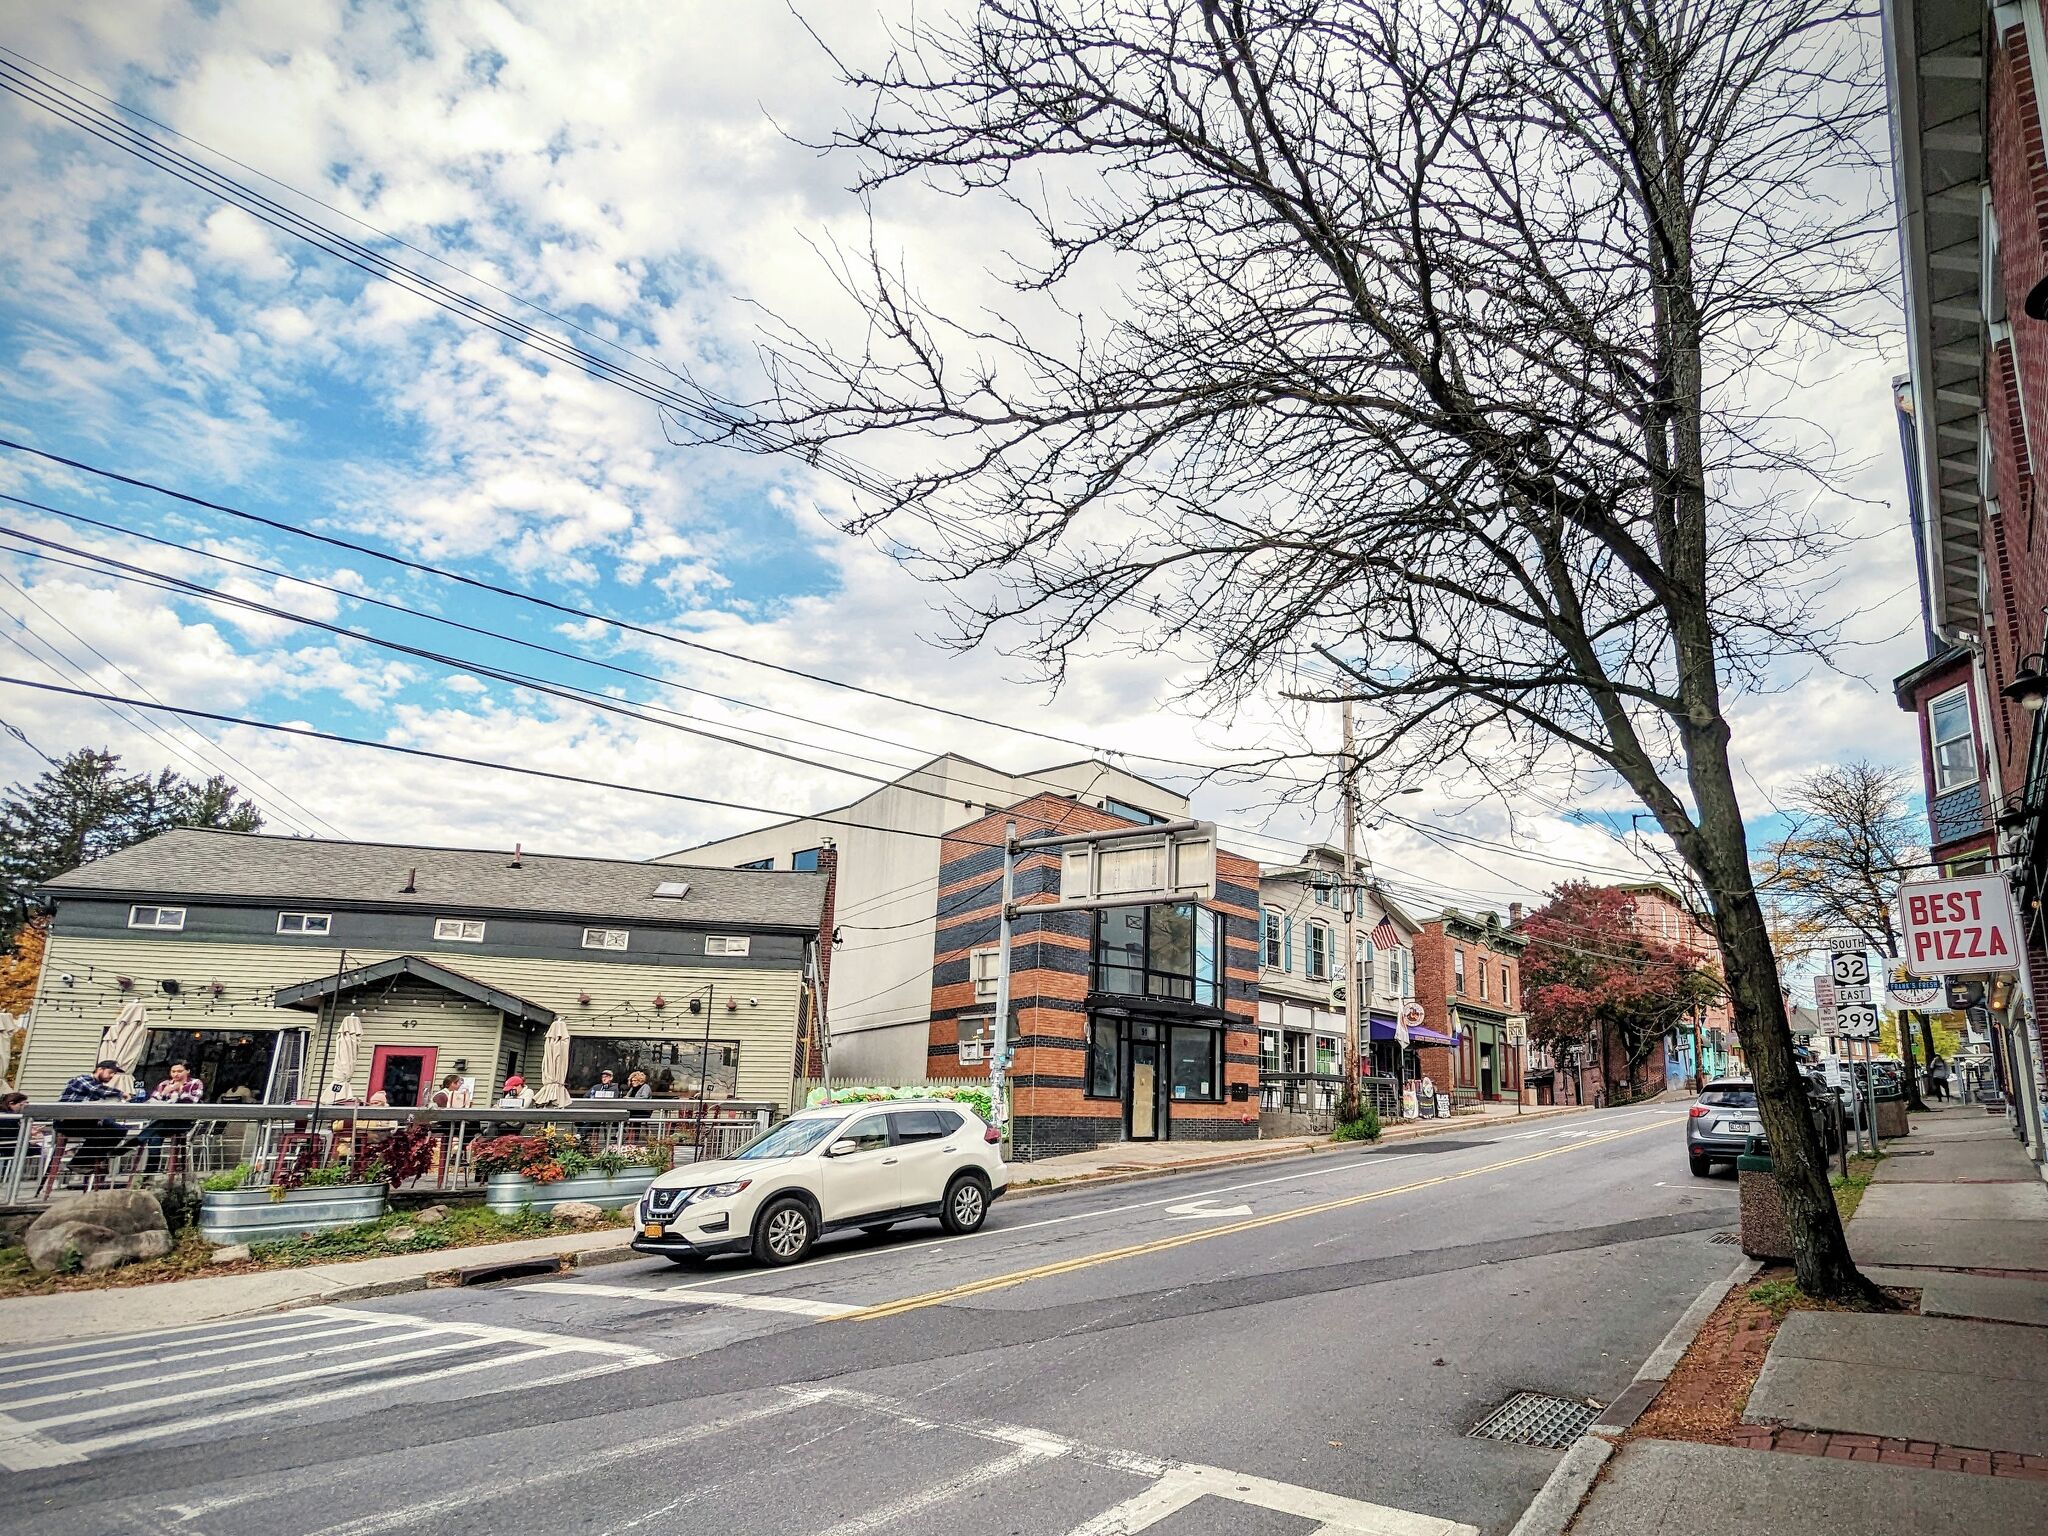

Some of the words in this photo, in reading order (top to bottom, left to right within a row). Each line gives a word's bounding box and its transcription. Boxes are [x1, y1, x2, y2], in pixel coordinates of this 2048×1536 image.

[1909, 891, 1982, 926] BEST
[1832, 938, 1864, 950] SOUTH
[1915, 926, 2008, 962] PIZZA
[1836, 960, 1865, 978] 32
[1890, 982, 1916, 990] FRANK'S
[1840, 989, 1865, 1000] EAST
[401, 1019, 418, 1029] 49
[1838, 1012, 1875, 1029] 299
[134, 1080, 145, 1088] 20
